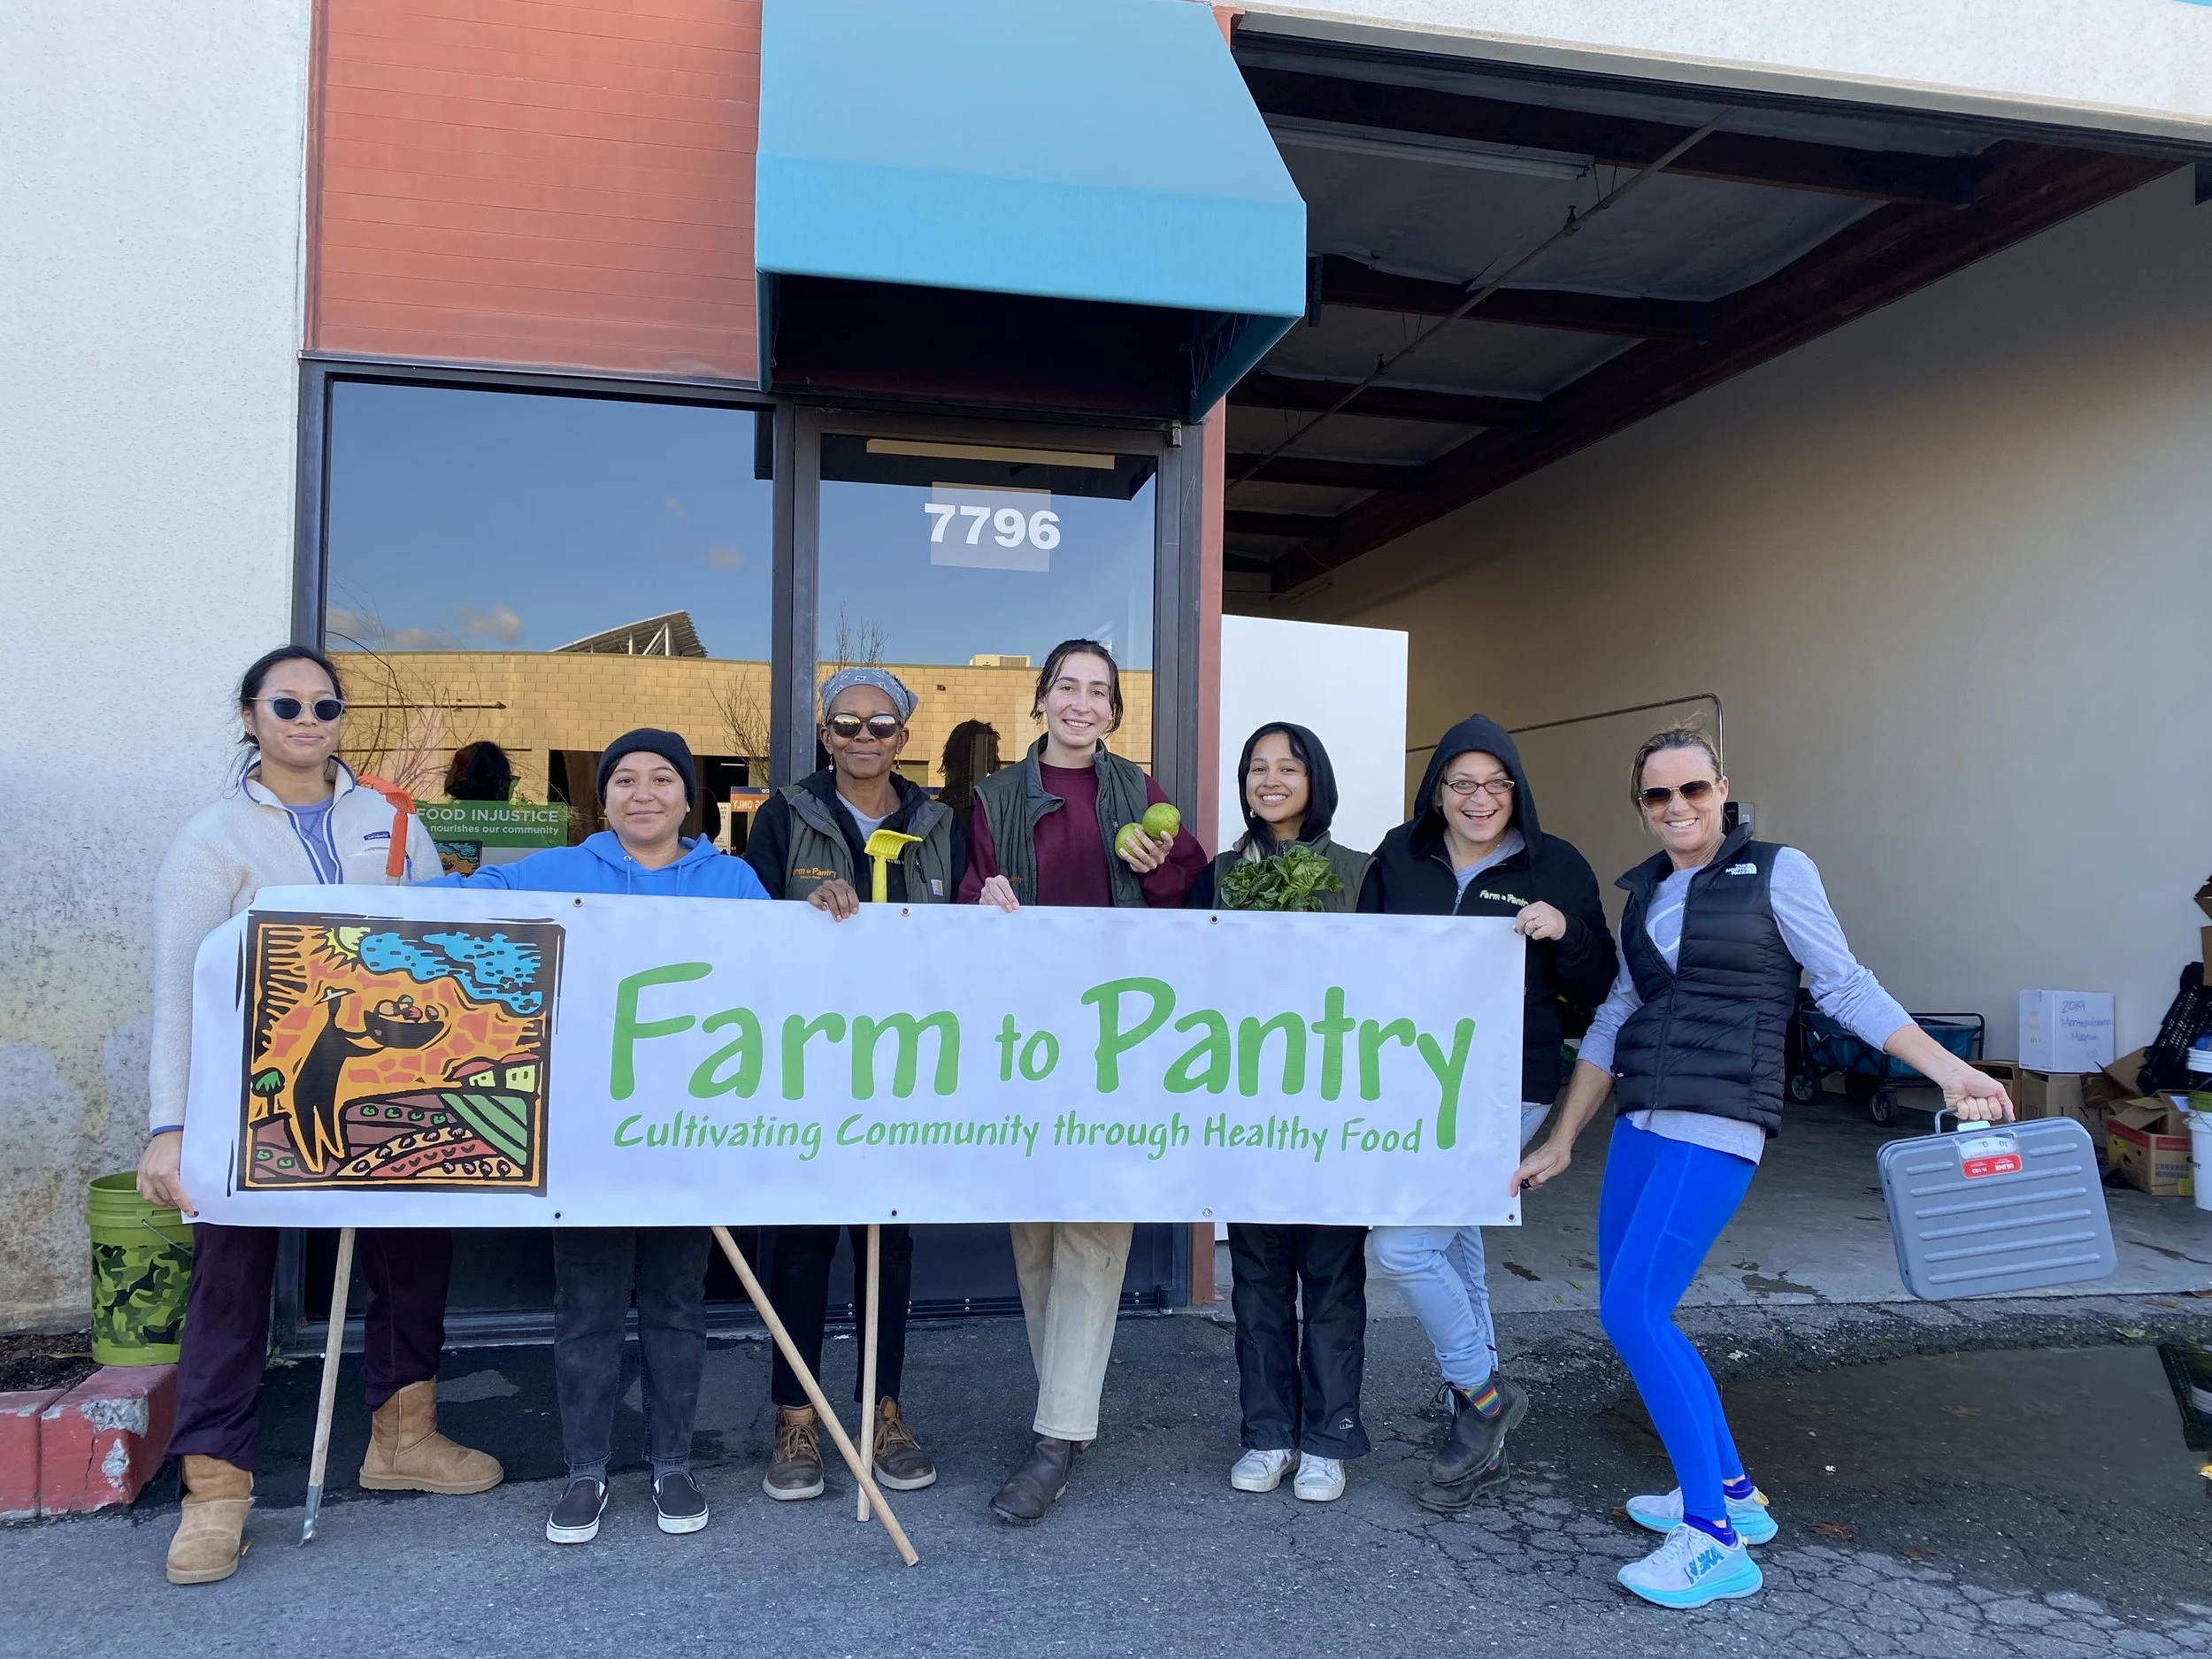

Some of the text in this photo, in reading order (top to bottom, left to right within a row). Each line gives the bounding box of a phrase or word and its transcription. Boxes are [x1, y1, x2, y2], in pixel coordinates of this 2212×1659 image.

[925, 503, 1061, 550] 7796
[417, 809, 559, 823] FOOD INJUSTICE
[430, 824, 480, 833] nourishes
[502, 826, 559, 836] community
[811, 867, 837, 879] Pantry
[1479, 889, 1501, 901] Farm
[1507, 894, 1529, 907] Pantr
[611, 961, 1476, 1150] Farm to Pantry
[613, 1110, 1423, 1163] Cultivating Community through Healthy Food
